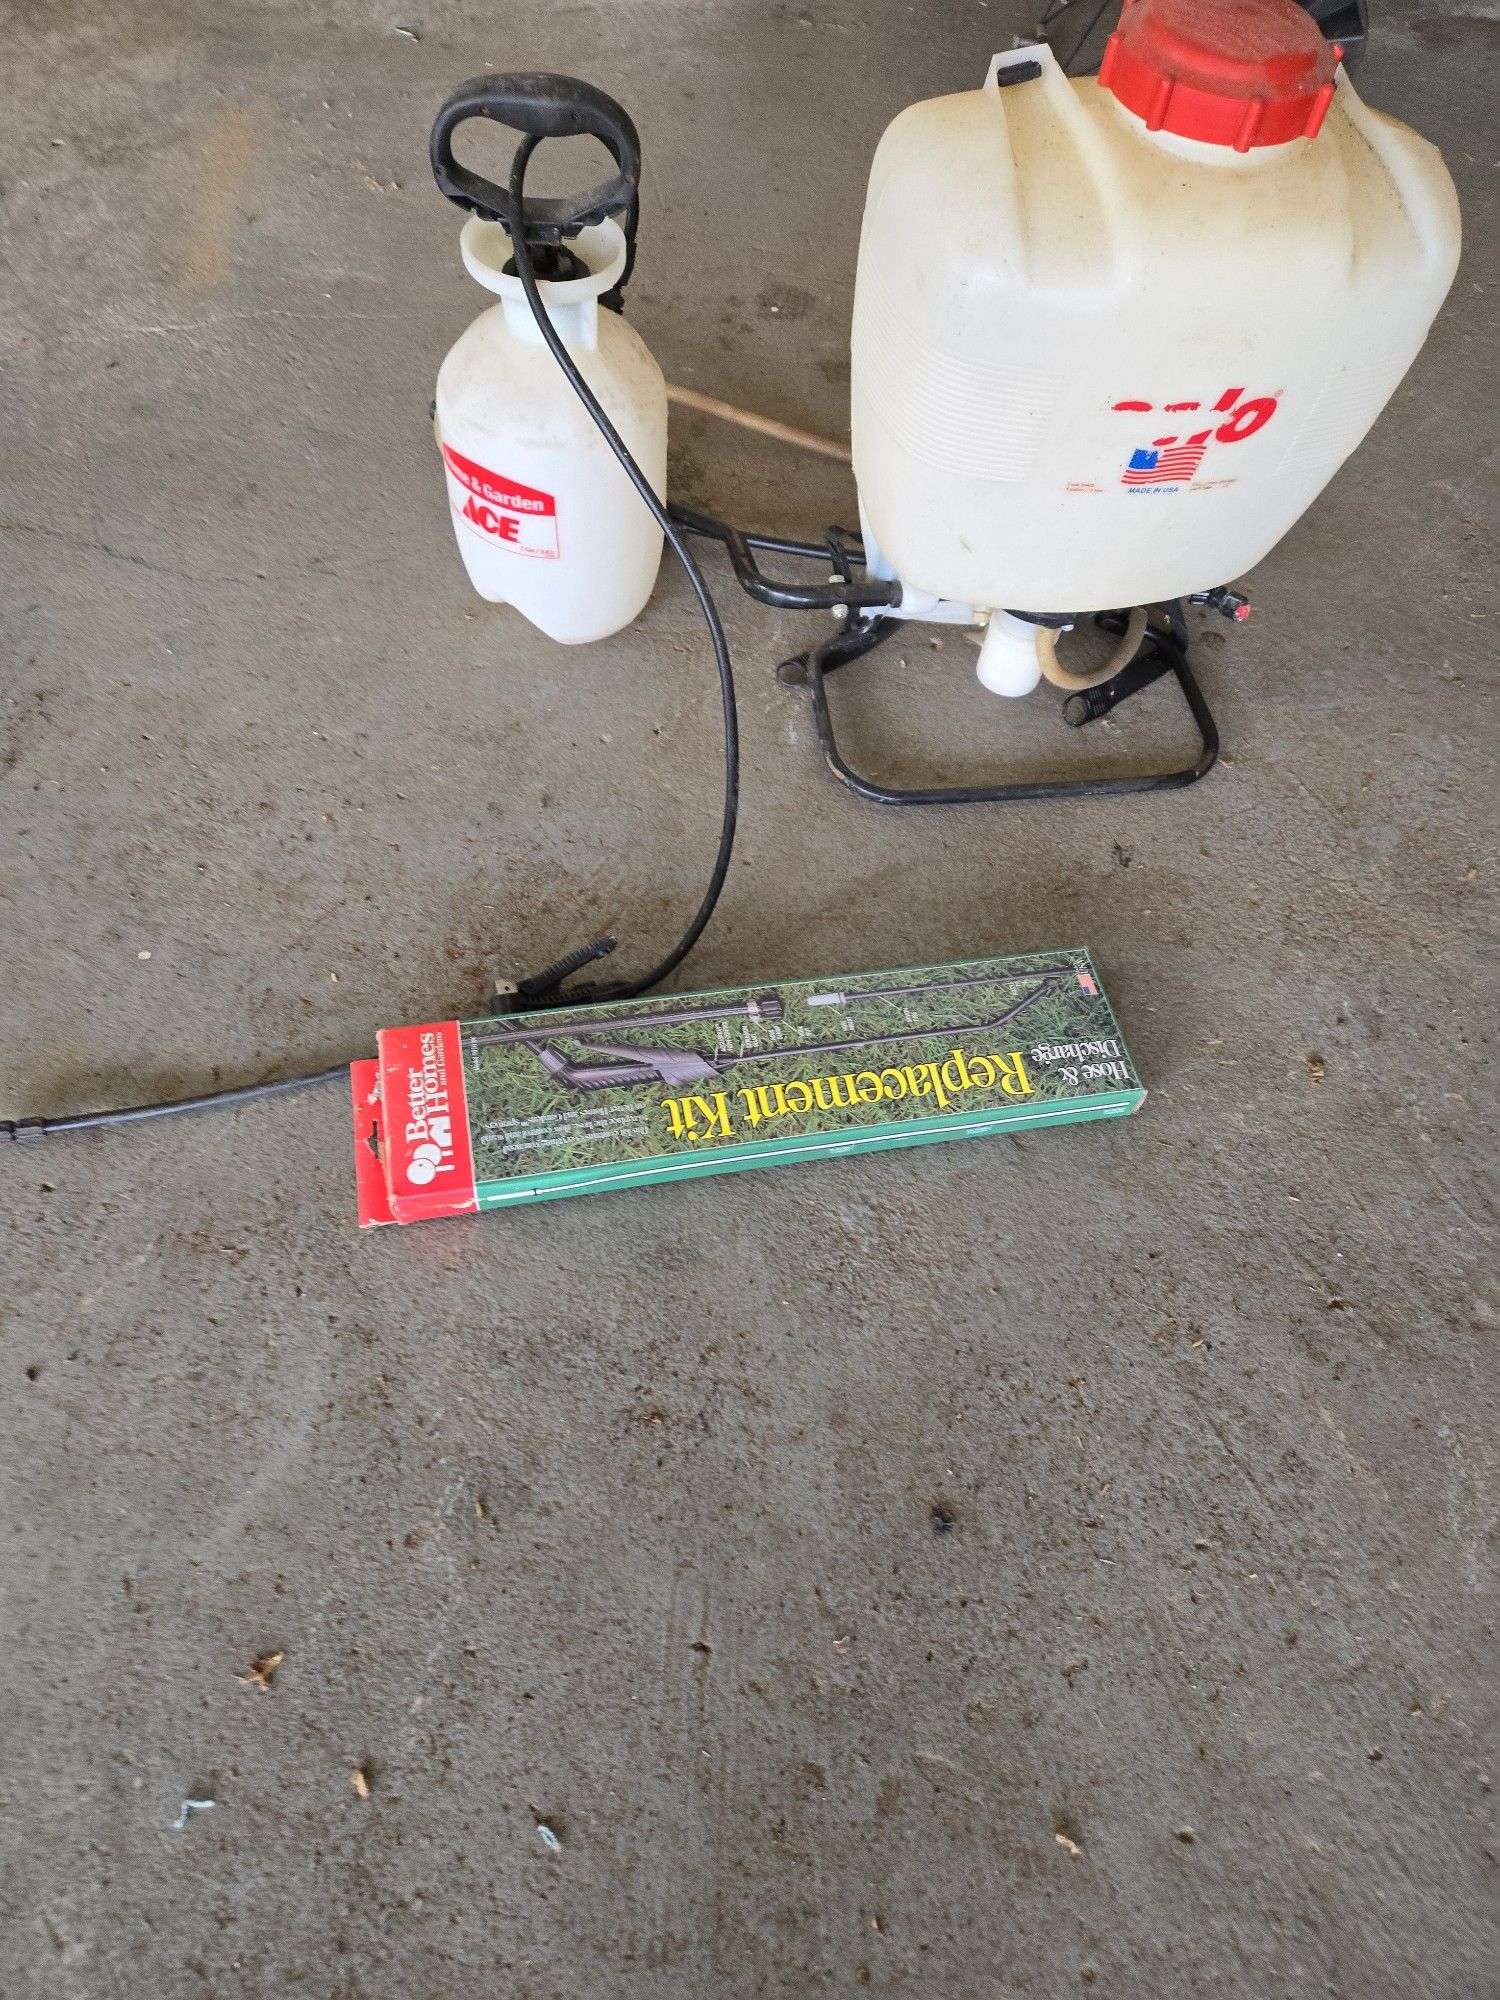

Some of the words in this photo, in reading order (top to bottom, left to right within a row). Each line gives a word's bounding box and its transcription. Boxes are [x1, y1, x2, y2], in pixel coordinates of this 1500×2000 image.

[469, 474, 482, 493] &
[483, 482, 545, 513] Garden
[1127, 486, 1151, 495] MADE
[1152, 486, 1162, 494] IN
[1162, 485, 1180, 494] USA
[463, 495, 520, 543] ACE
[420, 1032, 449, 1113] Homes
[1031, 1039, 1123, 1064] Discharge
[1080, 1060, 1130, 1080] Hose
[738, 1048, 1035, 1122] Replacement
[1058, 1066, 1079, 1086] &
[406, 1068, 428, 1142] Better
[661, 1090, 736, 1141] Kit
